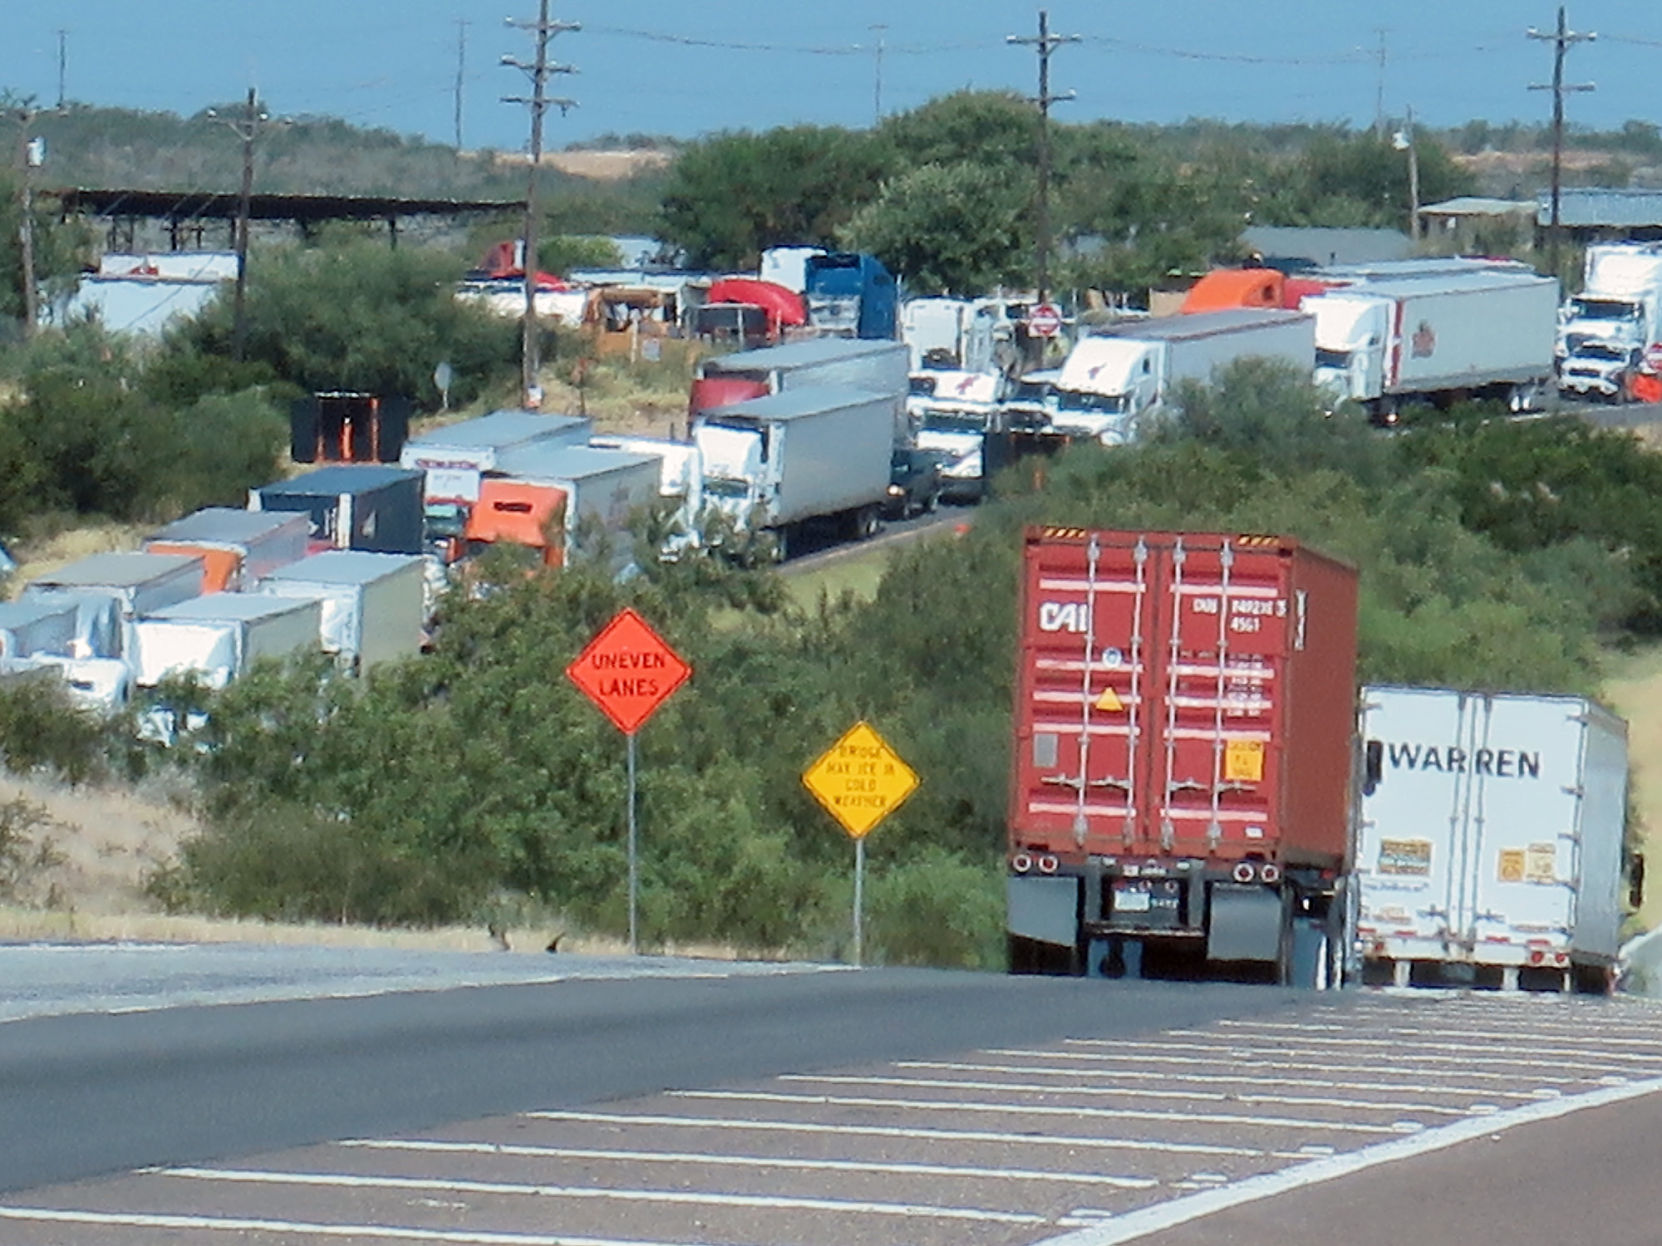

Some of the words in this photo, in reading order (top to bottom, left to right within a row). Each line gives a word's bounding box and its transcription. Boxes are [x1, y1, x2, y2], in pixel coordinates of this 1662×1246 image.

[1040, 602, 1088, 632] CAI
[592, 652, 665, 670] UNEVEN
[599, 677, 659, 696] LANES
[1388, 742, 1540, 779] WARREN
